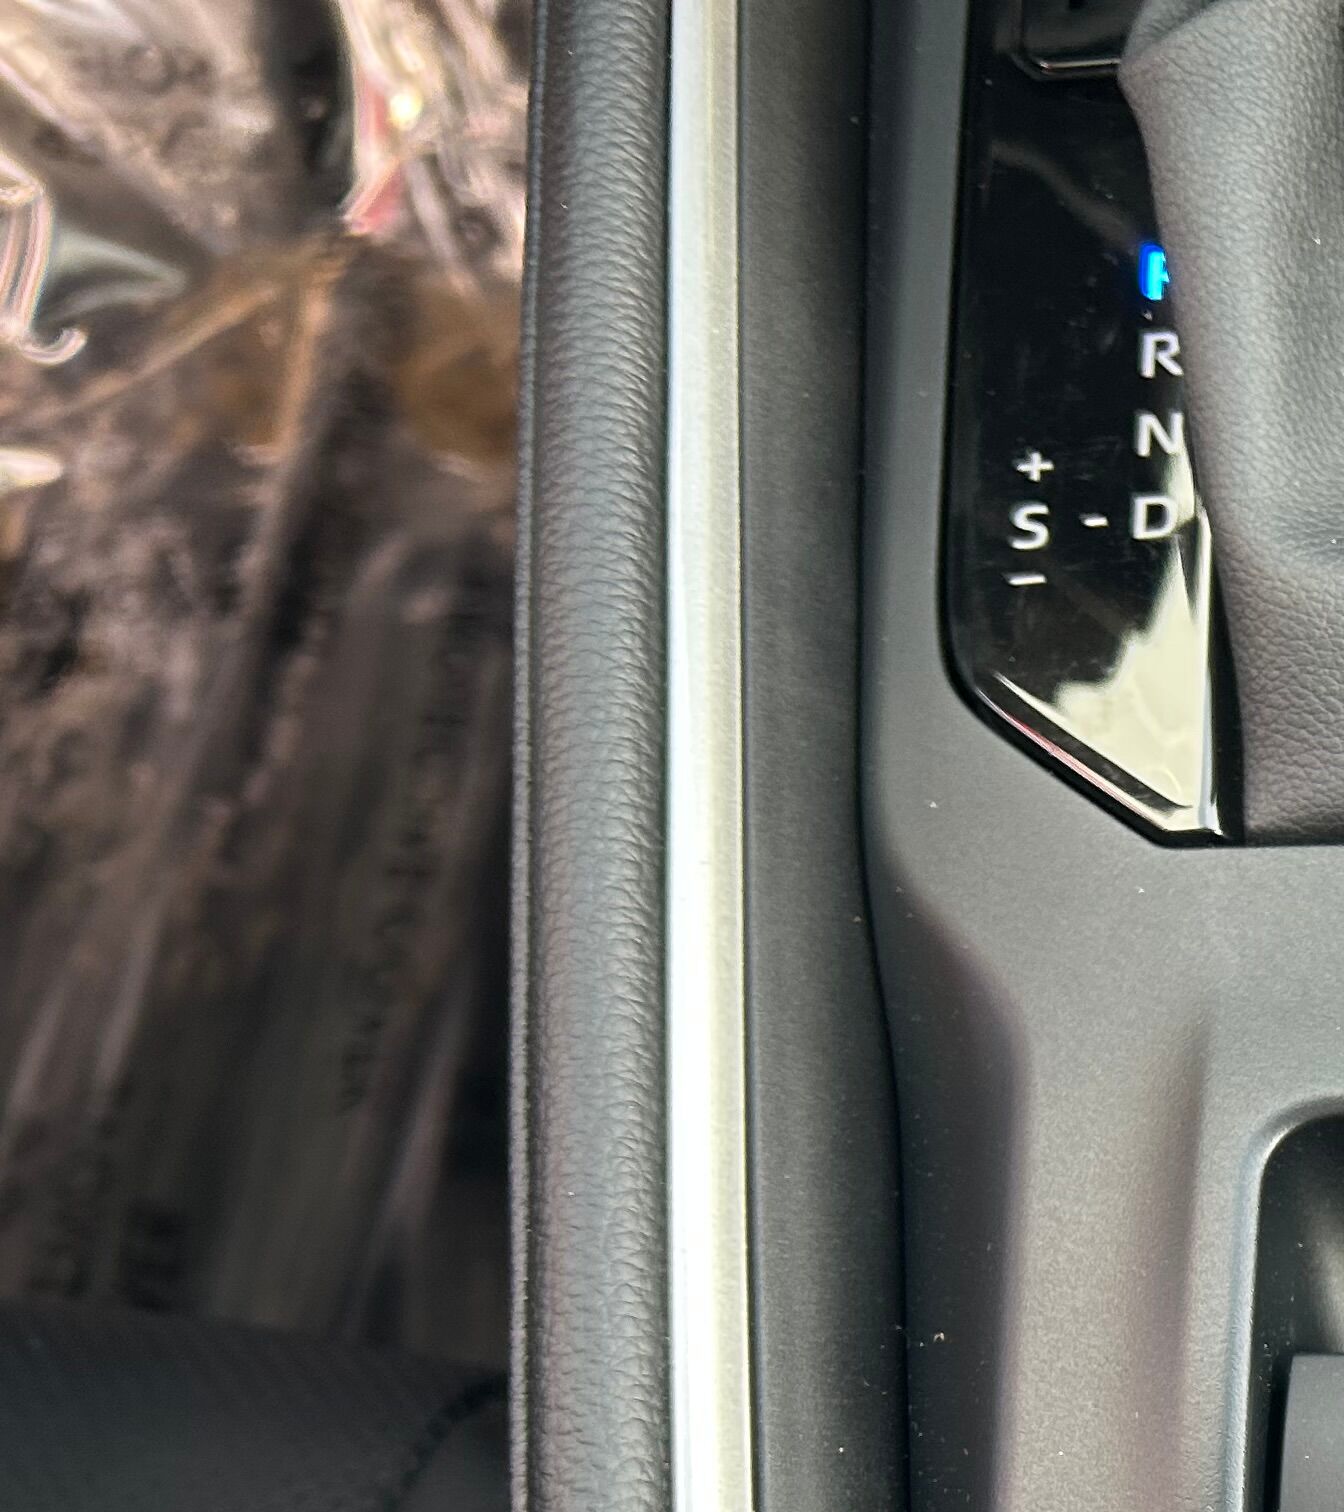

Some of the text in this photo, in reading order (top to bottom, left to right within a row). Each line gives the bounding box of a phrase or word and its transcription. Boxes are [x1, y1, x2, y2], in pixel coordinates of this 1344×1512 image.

[1140, 330, 1185, 379] R
[1134, 412, 1185, 458] N
[1010, 503, 1050, 551] S
[1131, 494, 1178, 541] D
